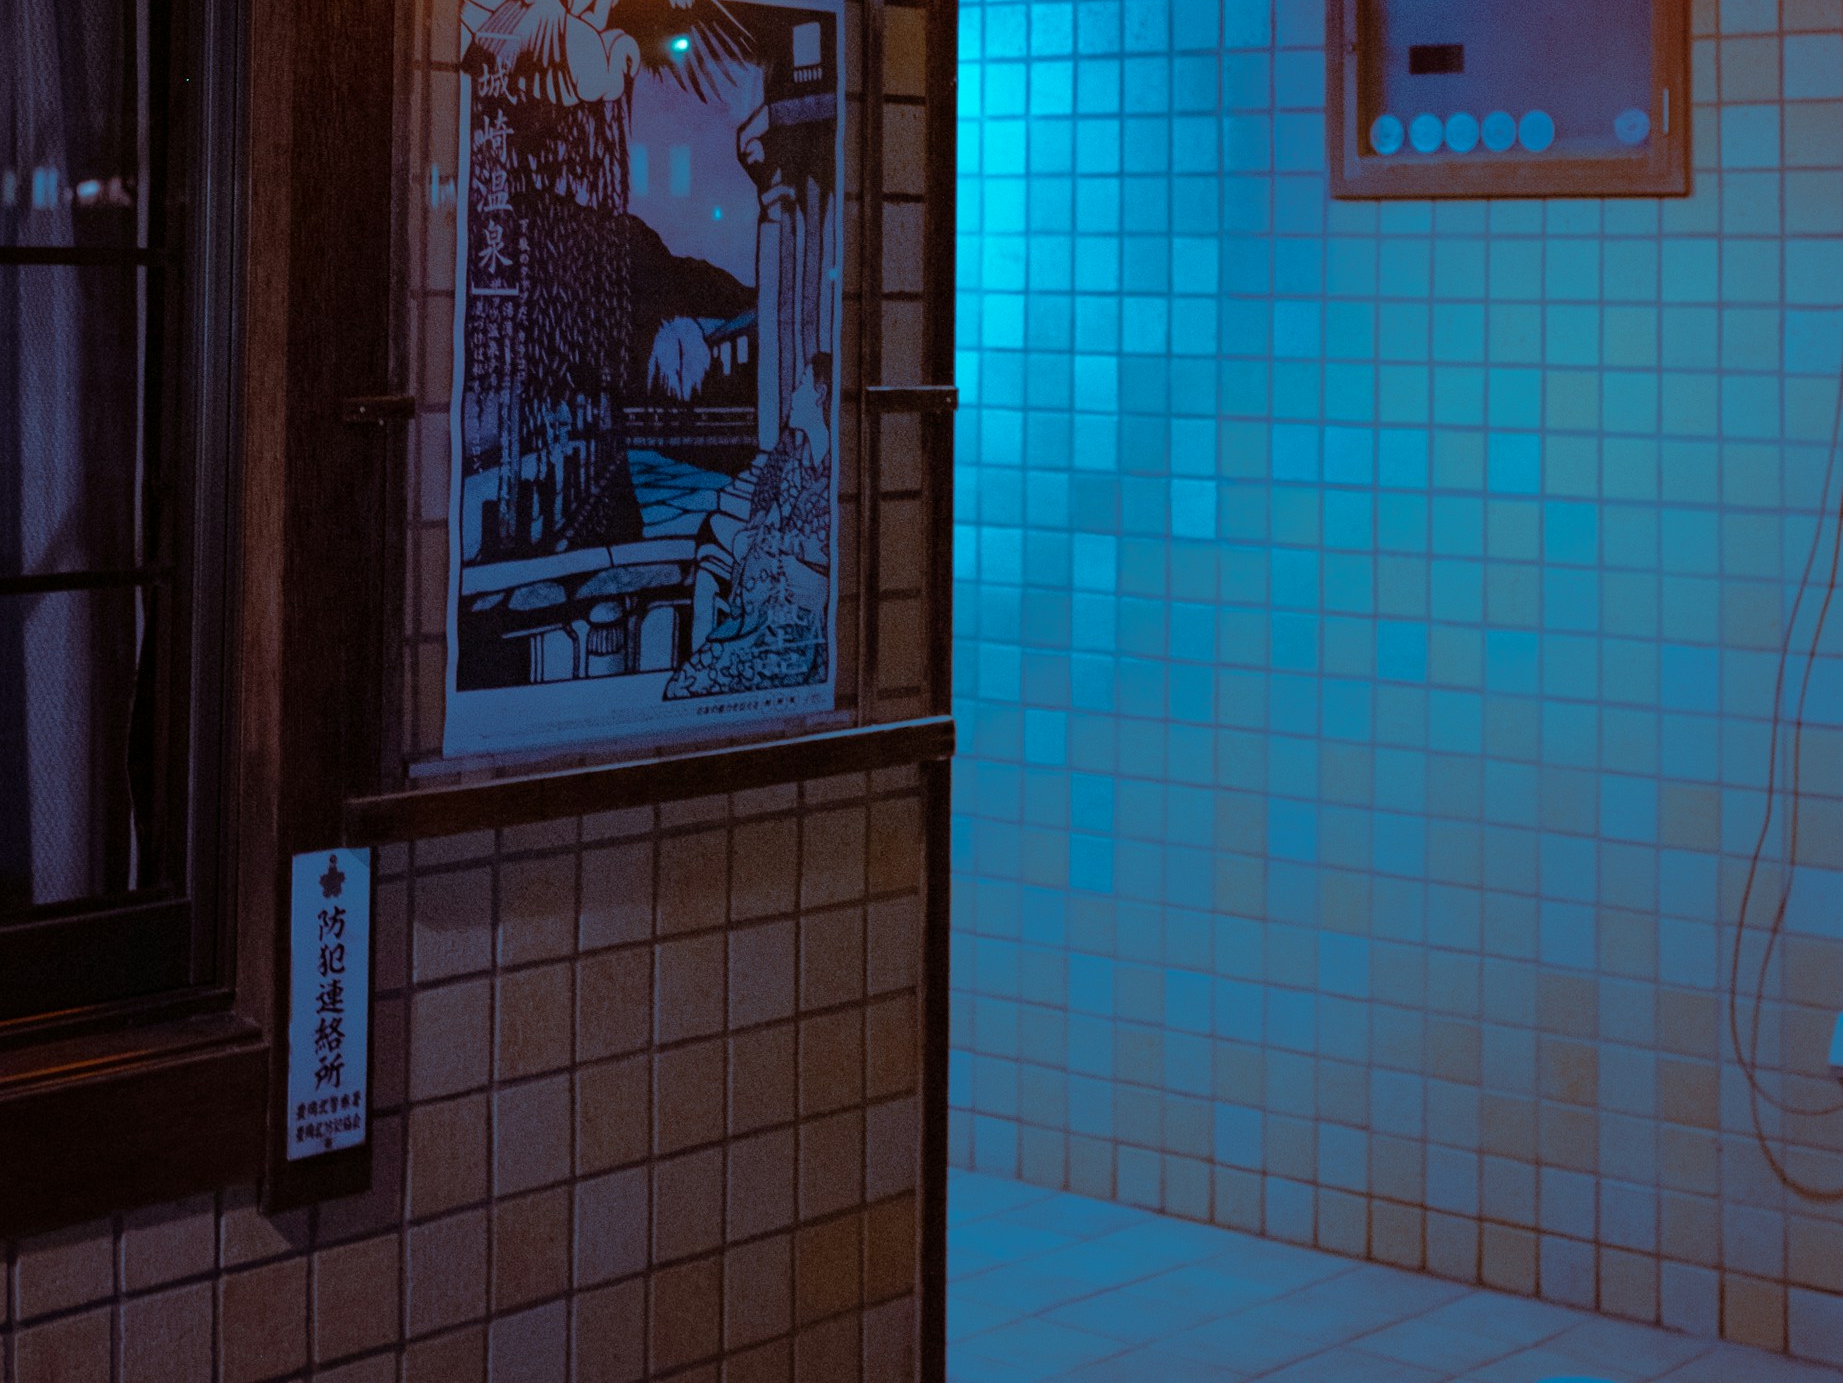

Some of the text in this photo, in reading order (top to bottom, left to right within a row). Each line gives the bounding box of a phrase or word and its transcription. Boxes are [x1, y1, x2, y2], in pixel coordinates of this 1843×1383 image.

[475, 56, 517, 274] 城崎温泉
[314, 904, 346, 1092] 防犯連絡所
